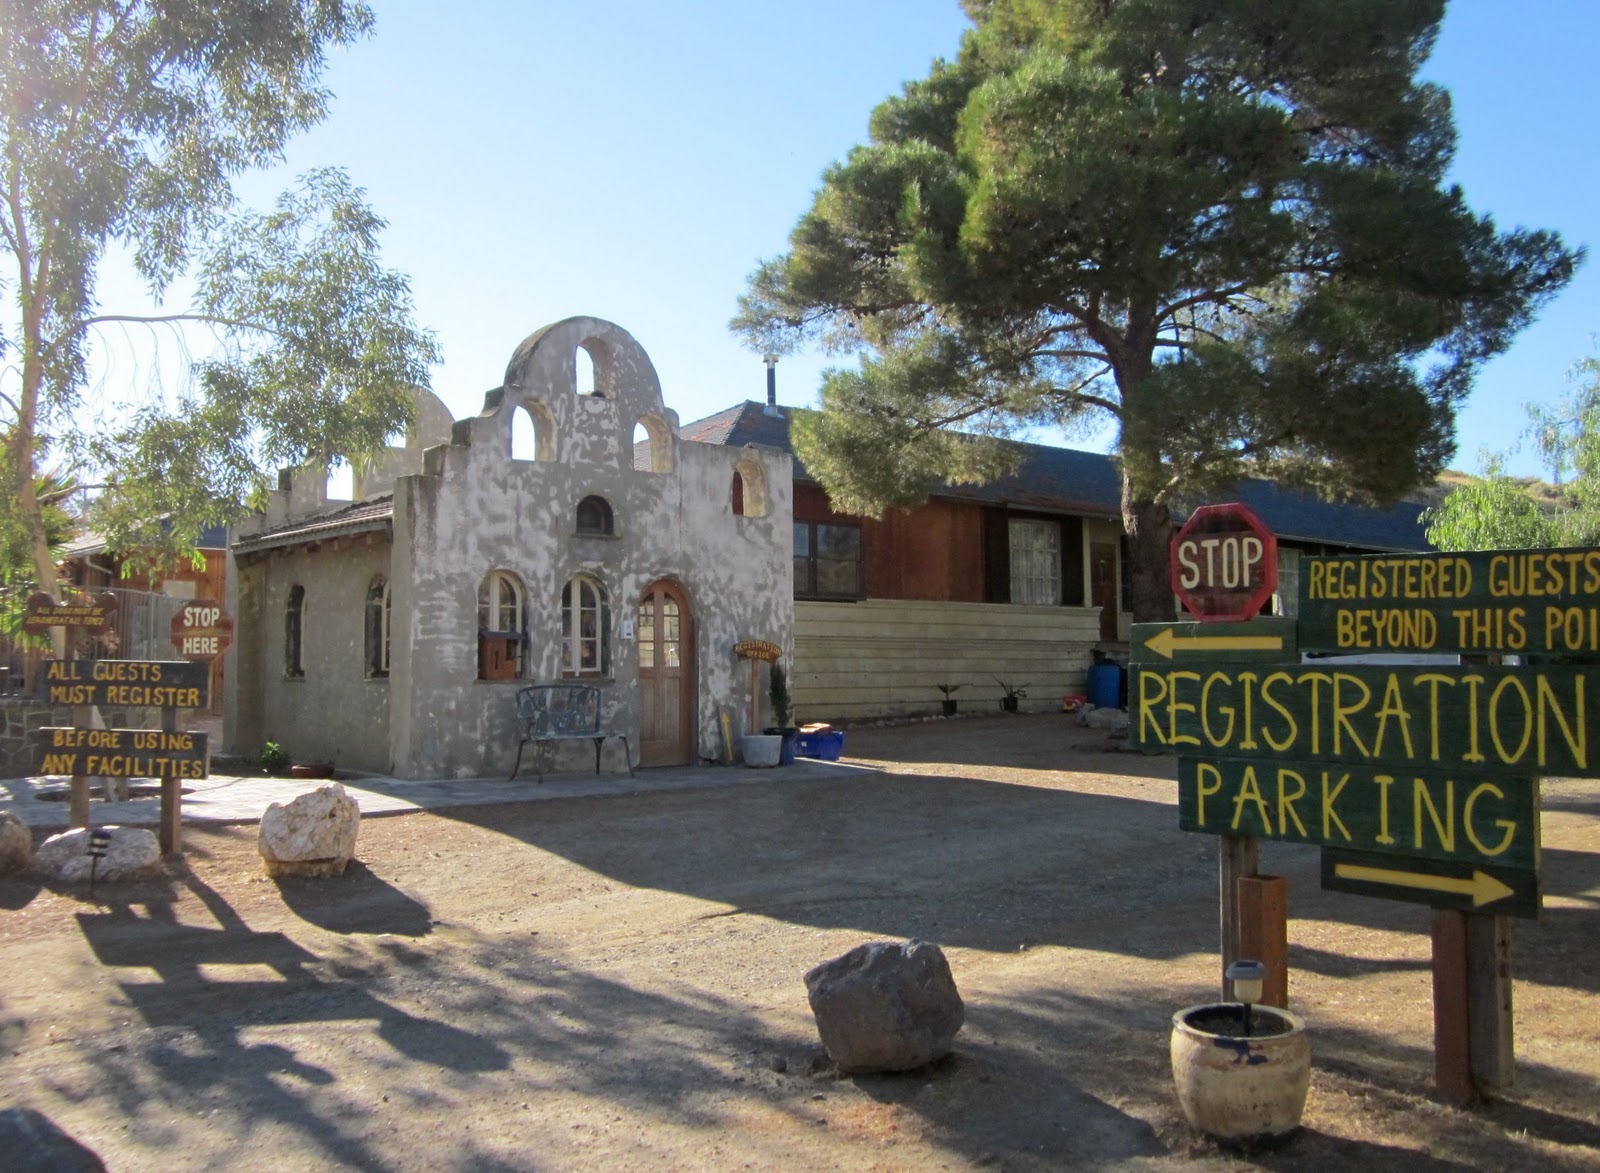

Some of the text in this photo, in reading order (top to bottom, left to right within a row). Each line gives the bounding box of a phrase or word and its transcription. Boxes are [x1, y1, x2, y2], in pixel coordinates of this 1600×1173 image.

[1178, 537, 1263, 589] STOP
[1308, 551, 1600, 600] REGISTERED GUESTS
[184, 606, 220, 627] STOP
[1337, 608, 1437, 649] BEYOND
[1452, 607, 1527, 649] THIS
[183, 637, 218, 654] HERE
[735, 640, 782, 656] REGISTRATION
[746, 650, 769, 659] OFFICE
[48, 661, 162, 682] ALL GUESTS
[50, 685, 200, 707] MUST REGISTER
[1138, 670, 1587, 769] REGISTRATION
[53, 730, 193, 750] BEFORE USING
[41, 754, 203, 778] ANY FACILITIES
[1196, 762, 1516, 856] PARKING
